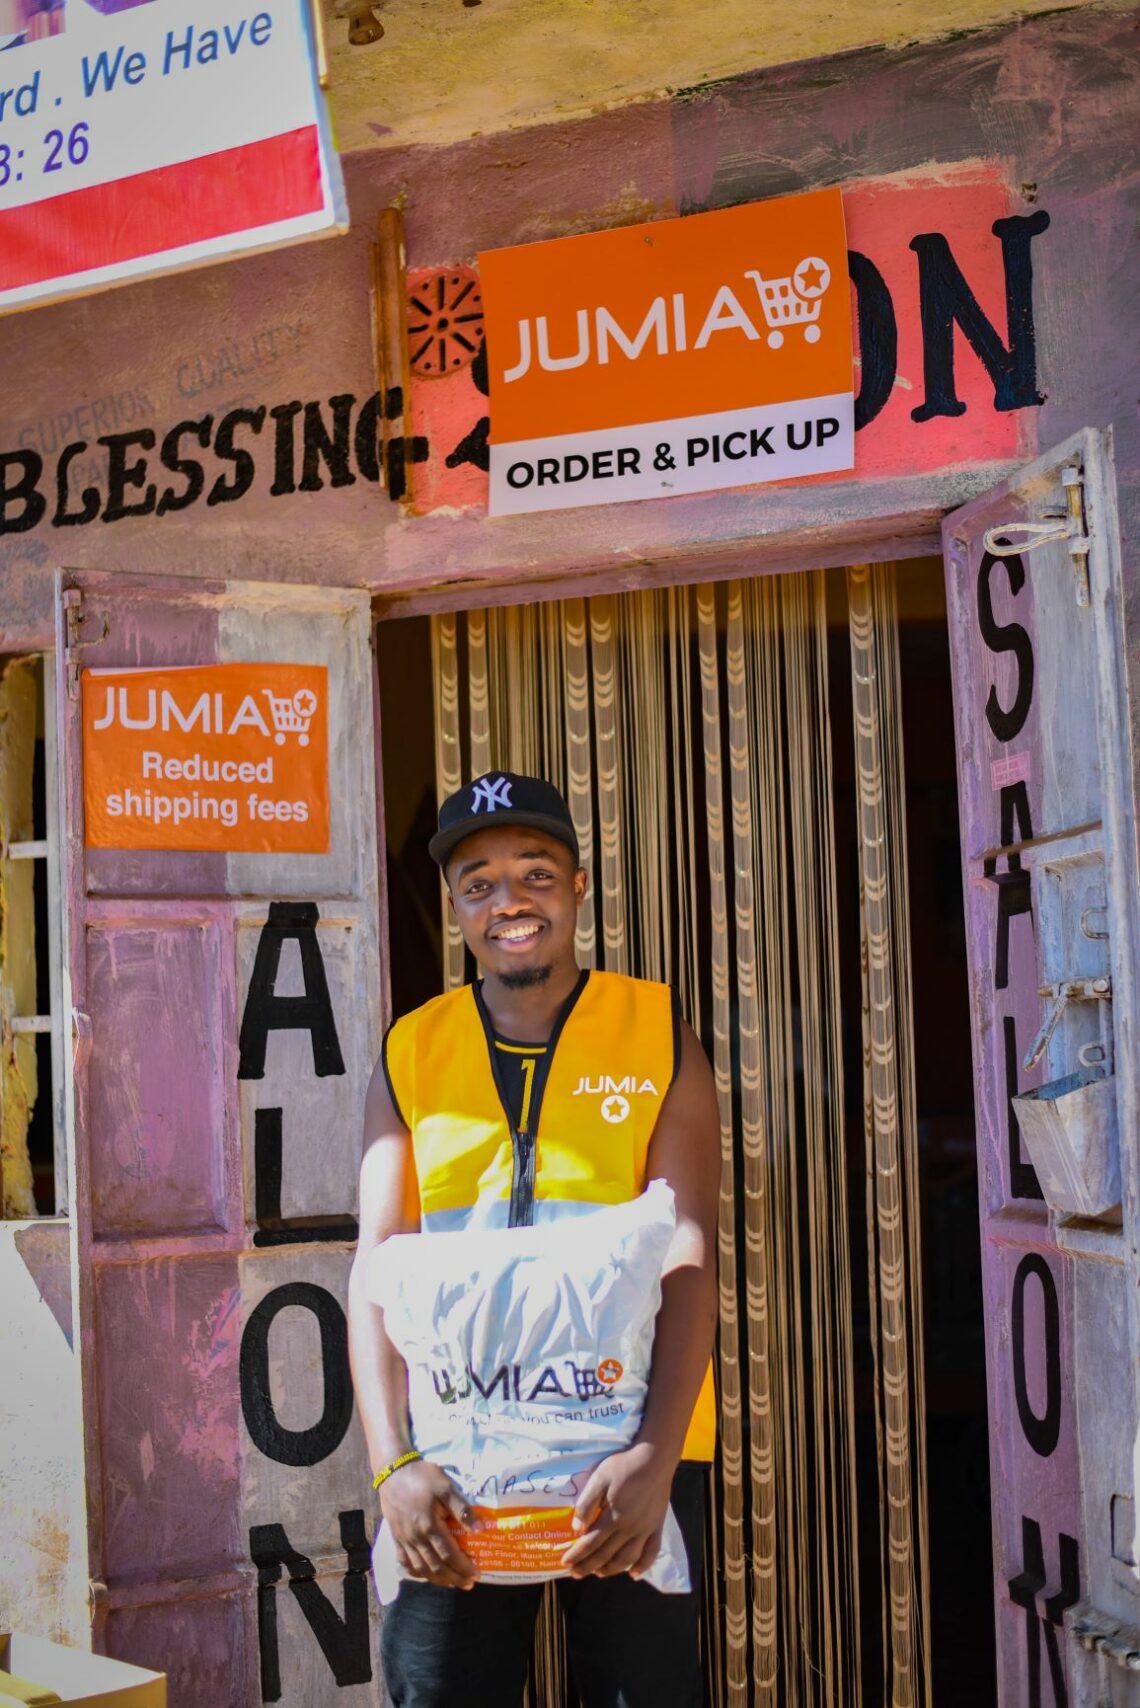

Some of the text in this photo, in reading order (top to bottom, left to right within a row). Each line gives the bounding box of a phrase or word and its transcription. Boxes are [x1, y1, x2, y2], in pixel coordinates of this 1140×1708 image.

[81, 45, 147, 98] We
[162, 11, 273, 76] Have
[42, 121, 90, 174] 26
[503, 285, 760, 383] JUMIA
[506, 417, 840, 489] ORDER & PICK UP
[94, 686, 271, 737] JUMIA
[142, 751, 273, 783] Reduced
[106, 789, 308, 827] shipping fees
[471, 776, 513, 814] NY
[572, 1075, 659, 1096] JUMIA
[588, 1402, 625, 1420] trust
[508, 1532, 542, 1541] Contact
